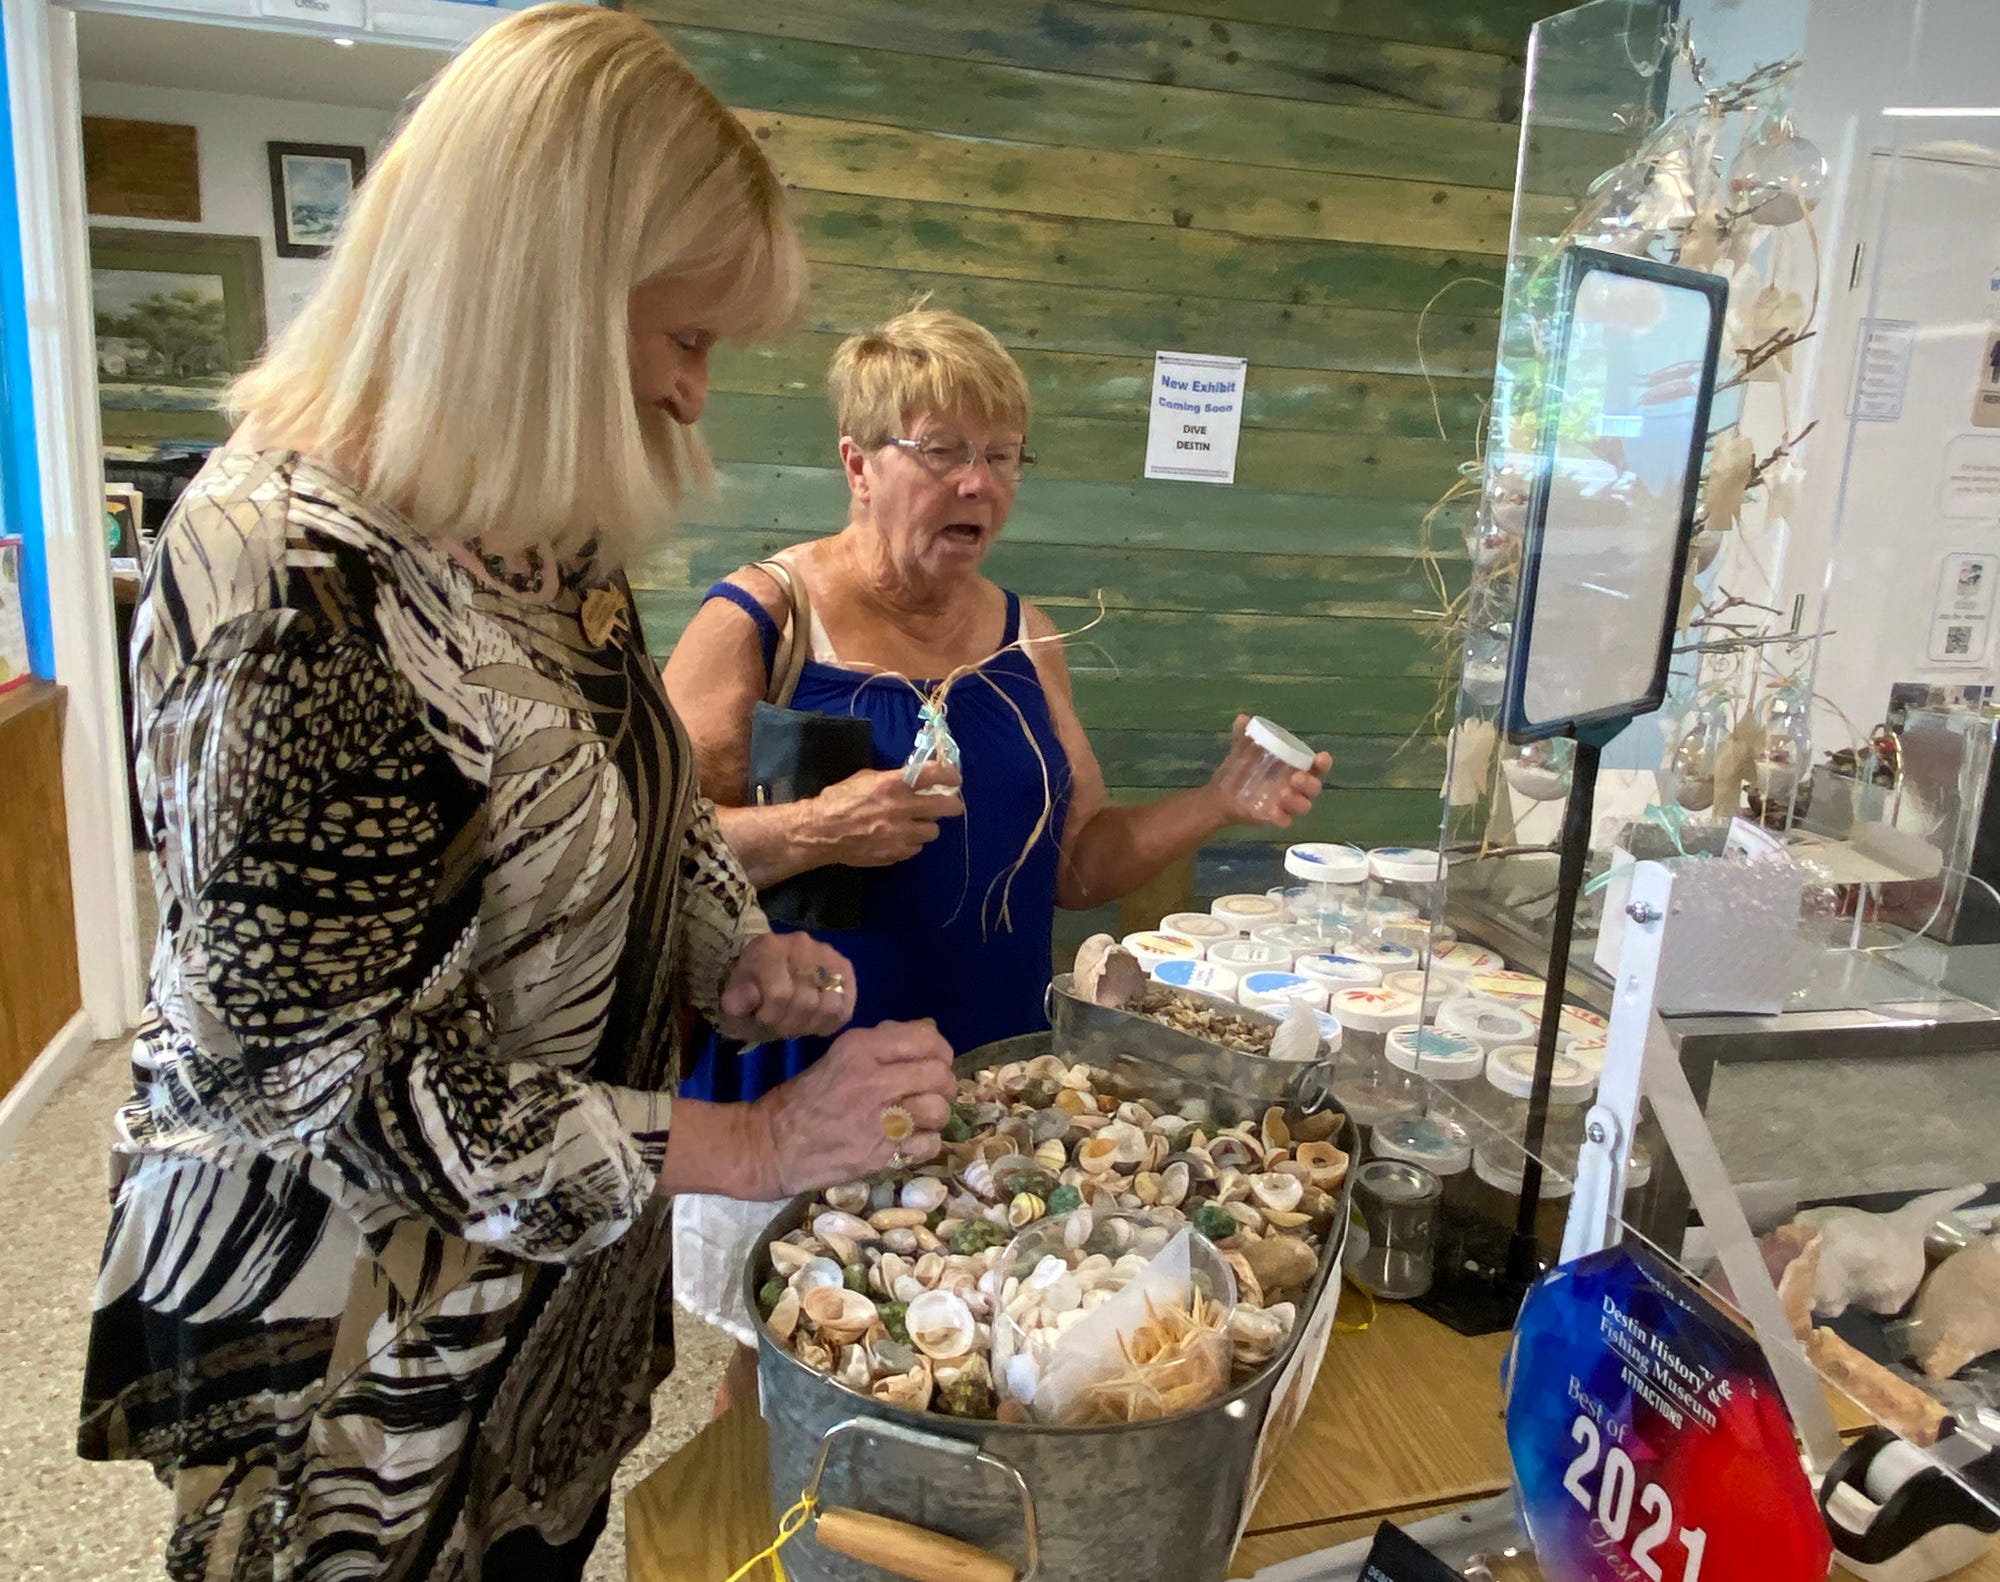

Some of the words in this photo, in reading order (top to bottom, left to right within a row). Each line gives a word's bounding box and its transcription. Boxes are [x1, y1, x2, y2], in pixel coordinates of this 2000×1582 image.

[1159, 397, 1201, 414] Coming
[1204, 403, 1233, 412] Soon
[1162, 375, 1188, 390] New
[1192, 381, 1236, 393] Exhibit
[1176, 440, 1211, 451] DESTIN
[1183, 424, 1207, 435] DIVE
[1602, 1294, 1647, 1345] Destin
[1650, 1333, 1705, 1394] History
[1600, 1316, 1649, 1374] Fishing
[1652, 1360, 1717, 1429] Museum
[1620, 1366, 1683, 1430] ATTRACTIONS
[1568, 1374, 1603, 1425] Best
[1563, 1415, 1707, 1582] 2021
